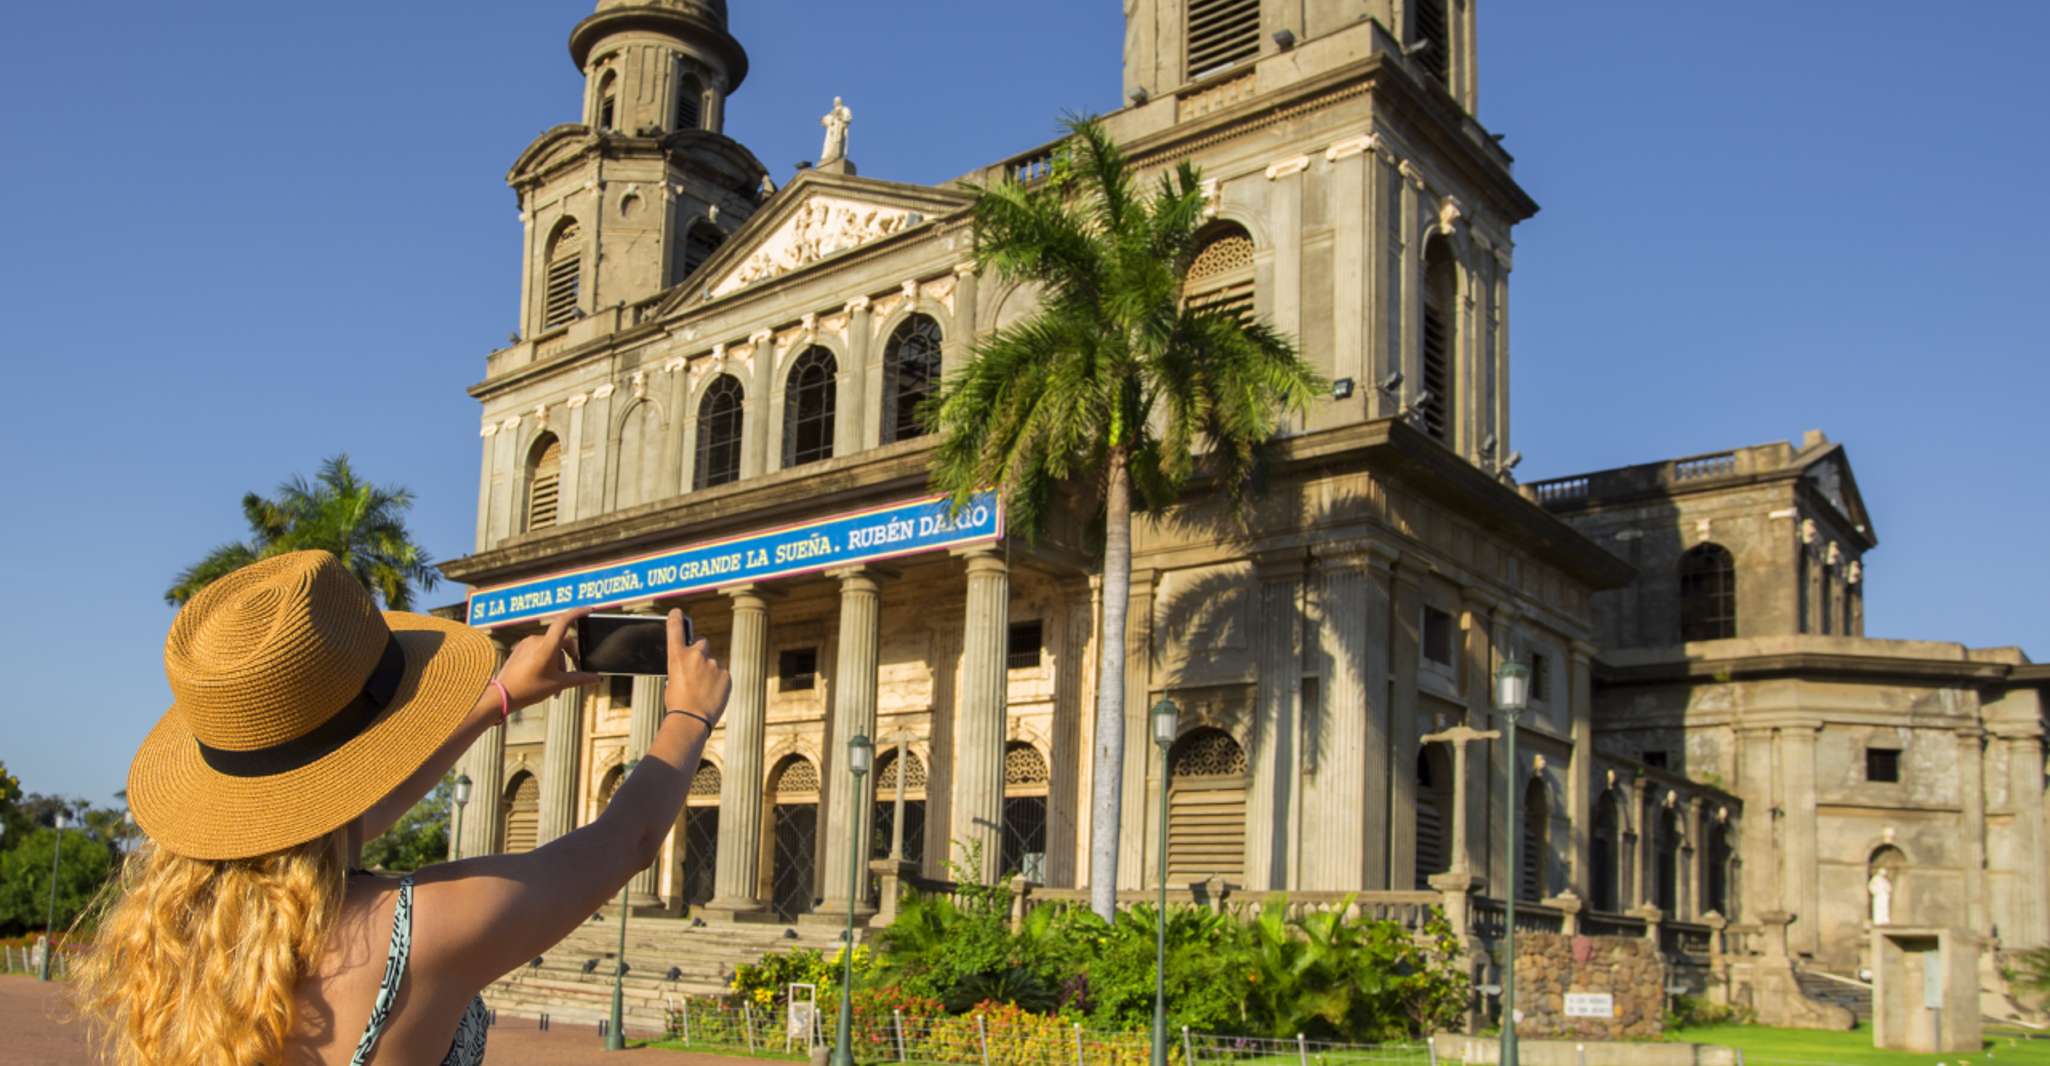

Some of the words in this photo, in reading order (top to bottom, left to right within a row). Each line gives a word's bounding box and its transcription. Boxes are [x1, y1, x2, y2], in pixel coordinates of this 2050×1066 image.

[473, 602, 486, 619] SI
[488, 599, 505, 616] LA
[510, 590, 552, 612] PATRIA
[556, 585, 573, 603] ES
[578, 570, 644, 599] PEQUEÑA,
[647, 565, 677, 586] UNO
[680, 553, 742, 580] GRANDE
[745, 548, 769, 568] LA
[848, 516, 915, 550] RUBÉN
